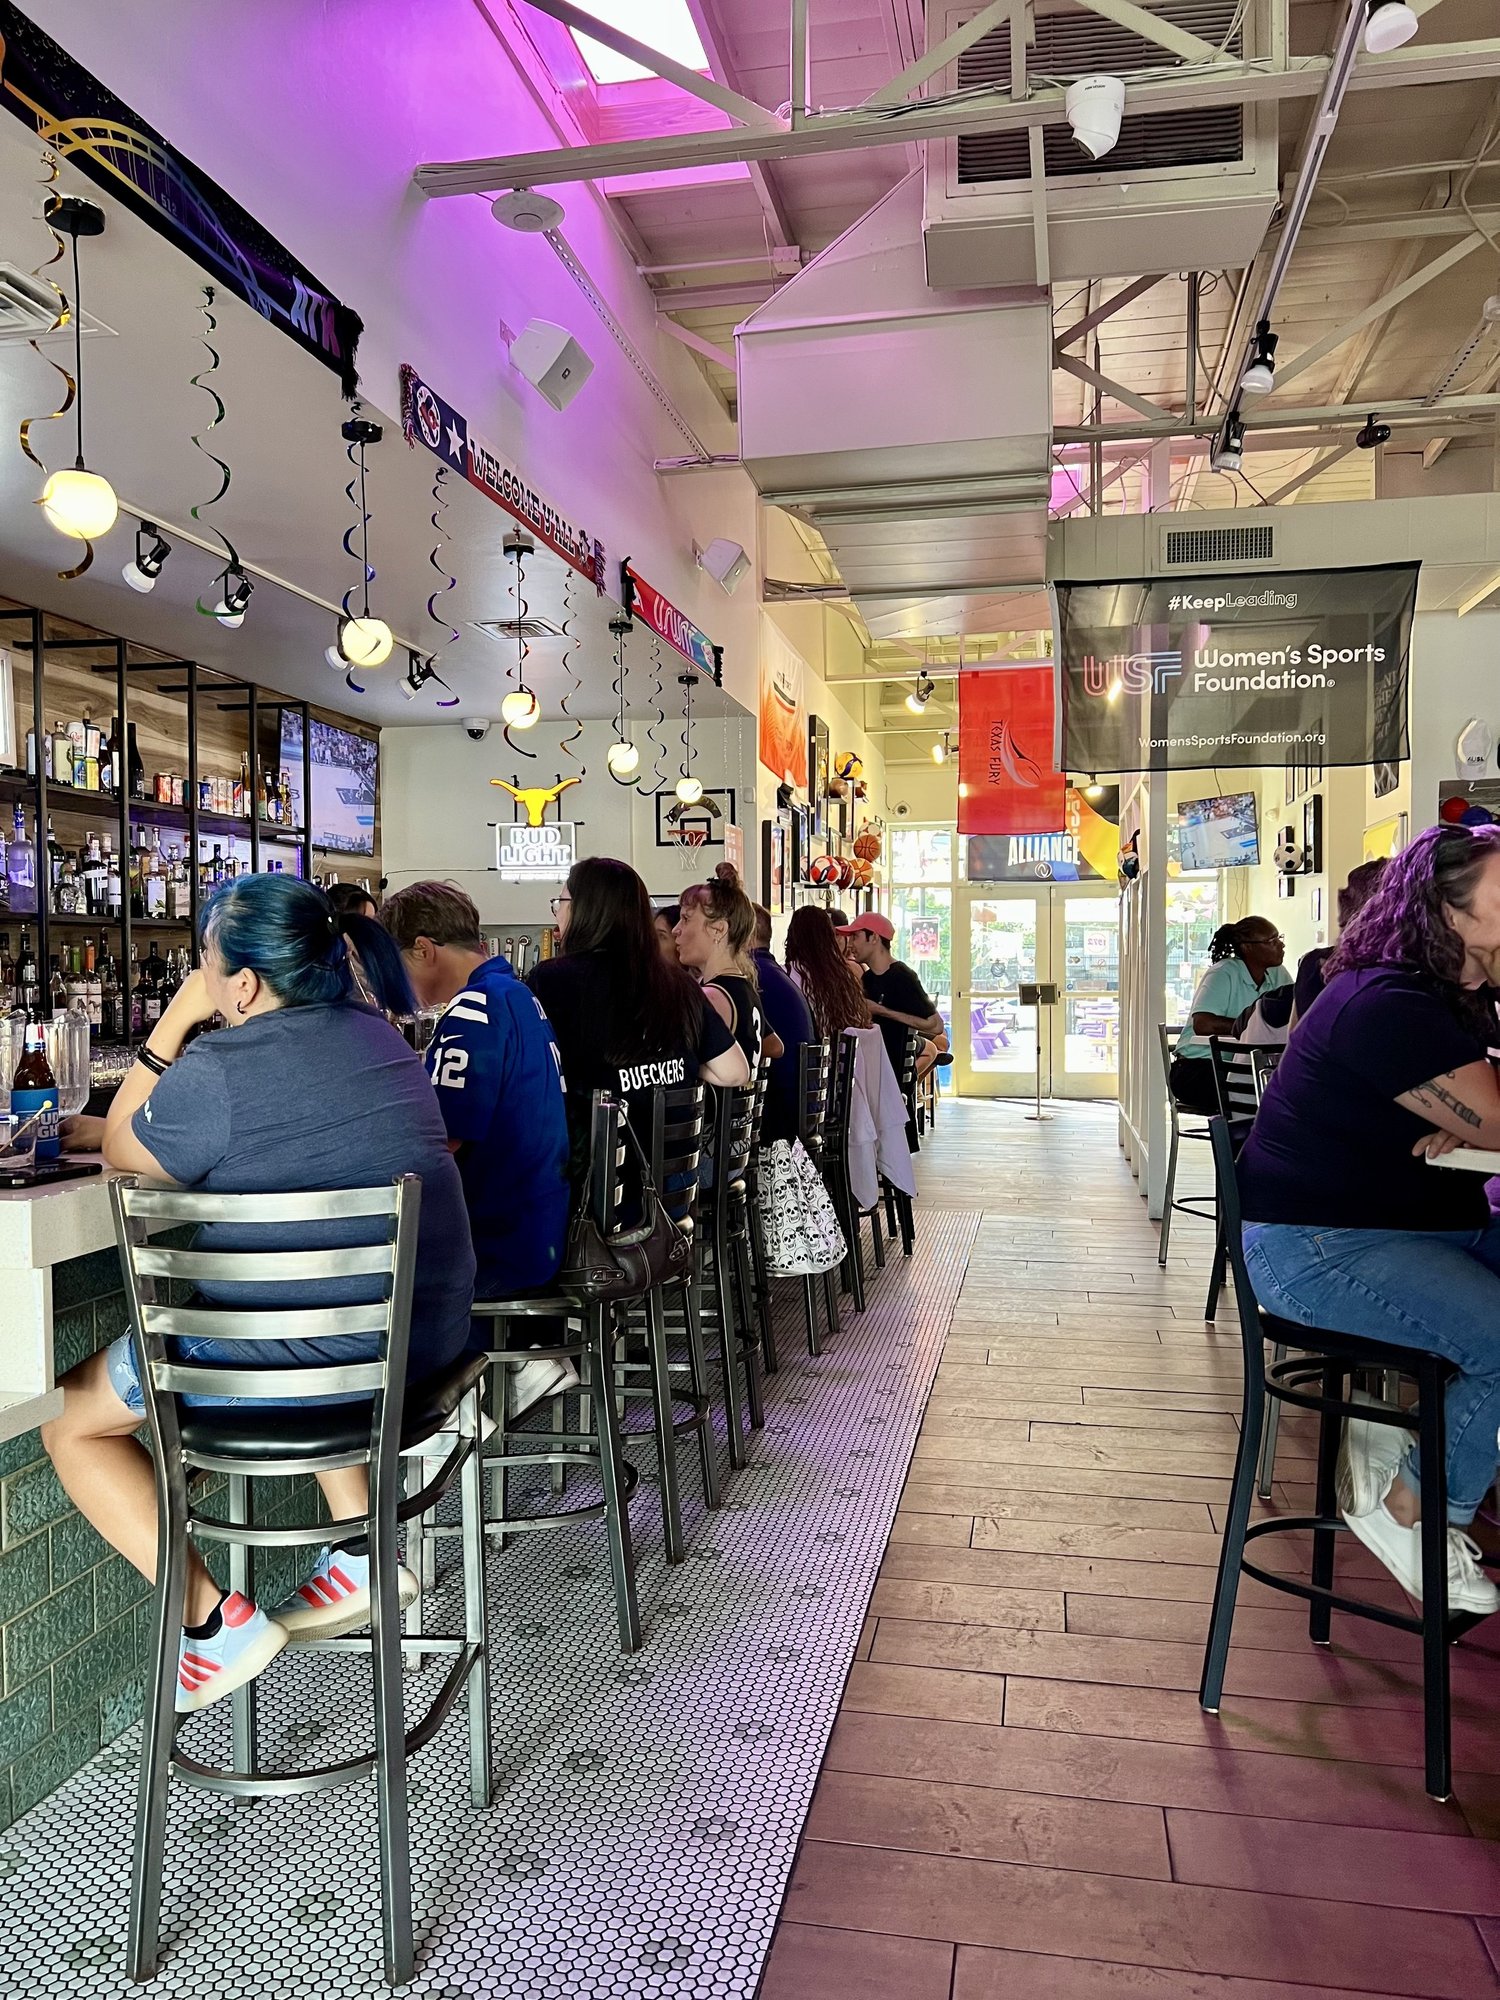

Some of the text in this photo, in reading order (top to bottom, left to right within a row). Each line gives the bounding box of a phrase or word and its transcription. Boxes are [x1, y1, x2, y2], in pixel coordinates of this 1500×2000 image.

[469, 438, 576, 558] WELCOME Y'ALL
[1168, 590, 1298, 612] #KeepLeading
[1194, 643, 1386, 670] Women's Sports
[988, 719, 1003, 786] TEXAS FURY
[1138, 732, 1327, 750] WomensSportsFoundation.org
[511, 827, 560, 846] BUD
[1008, 835, 1081, 866] ALLIANCE
[502, 846, 570, 865] LIGHT
[431, 1047, 469, 1089] 12
[618, 1057, 685, 1093] BUECKERS
